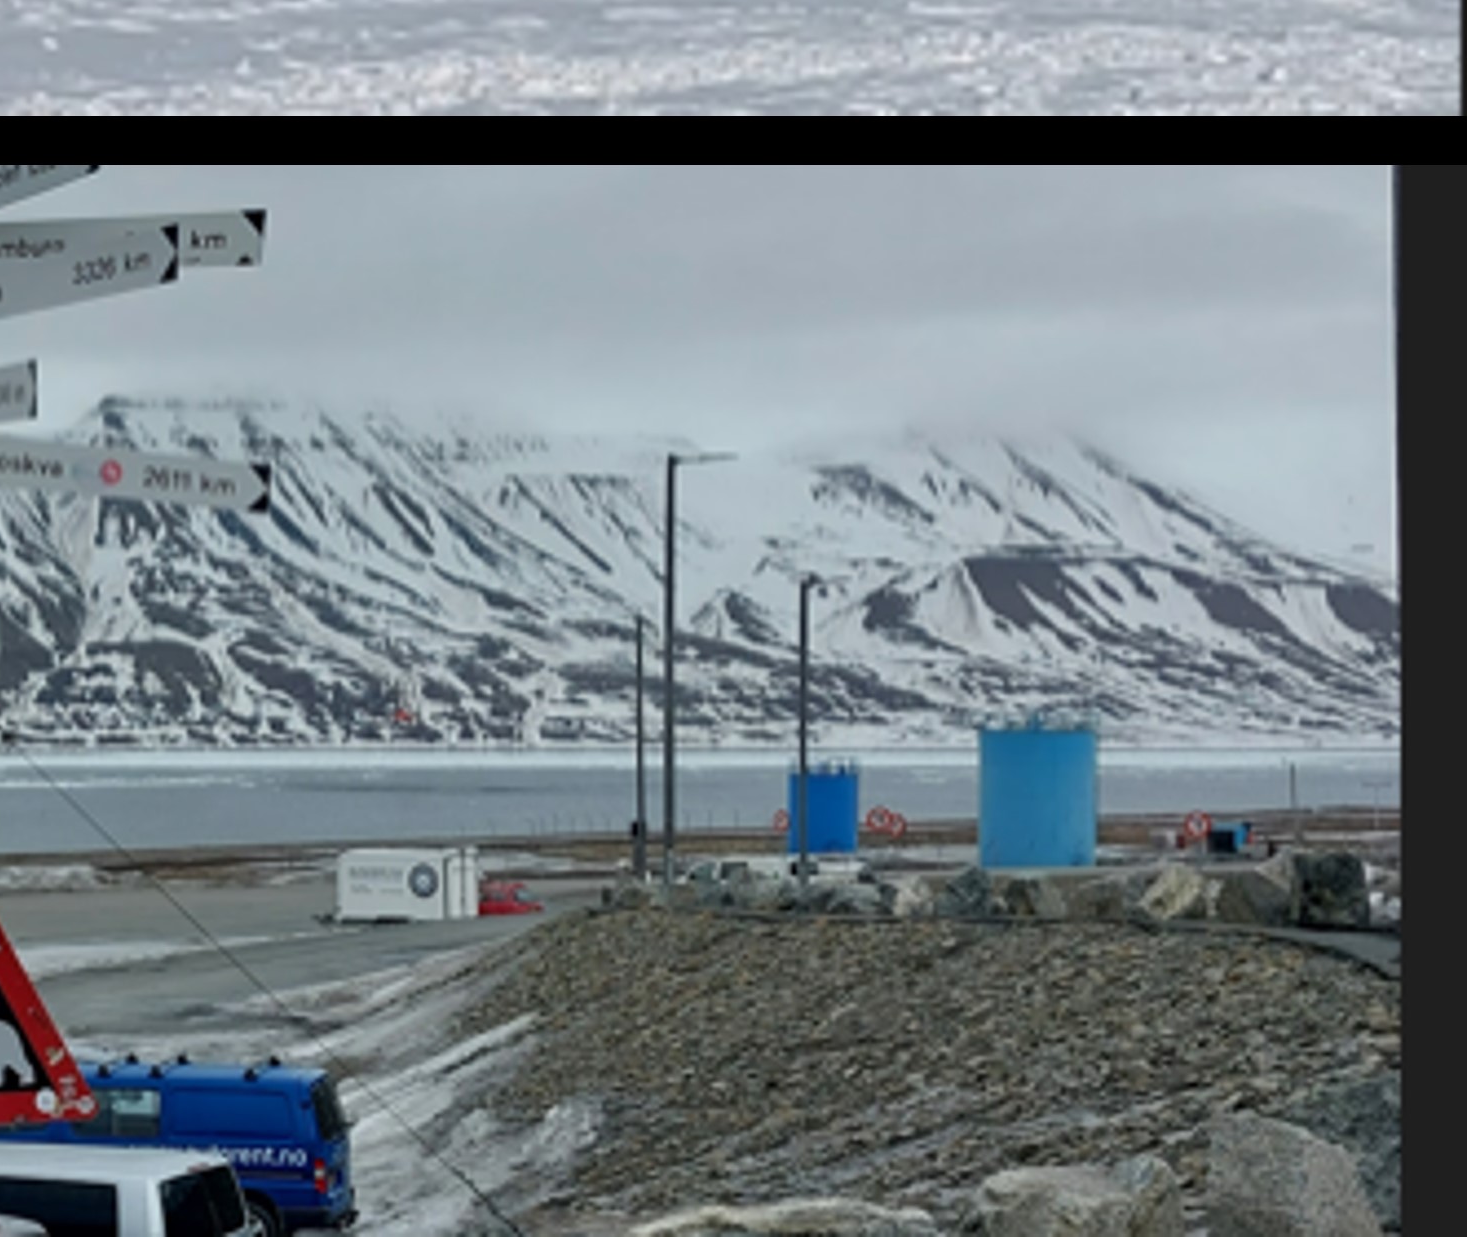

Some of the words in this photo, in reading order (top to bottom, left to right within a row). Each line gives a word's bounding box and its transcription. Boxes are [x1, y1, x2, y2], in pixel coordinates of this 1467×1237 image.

[190, 230, 226, 249] km
[124, 252, 151, 272] km
[142, 464, 192, 490] 2611
[198, 473, 236, 497] km
